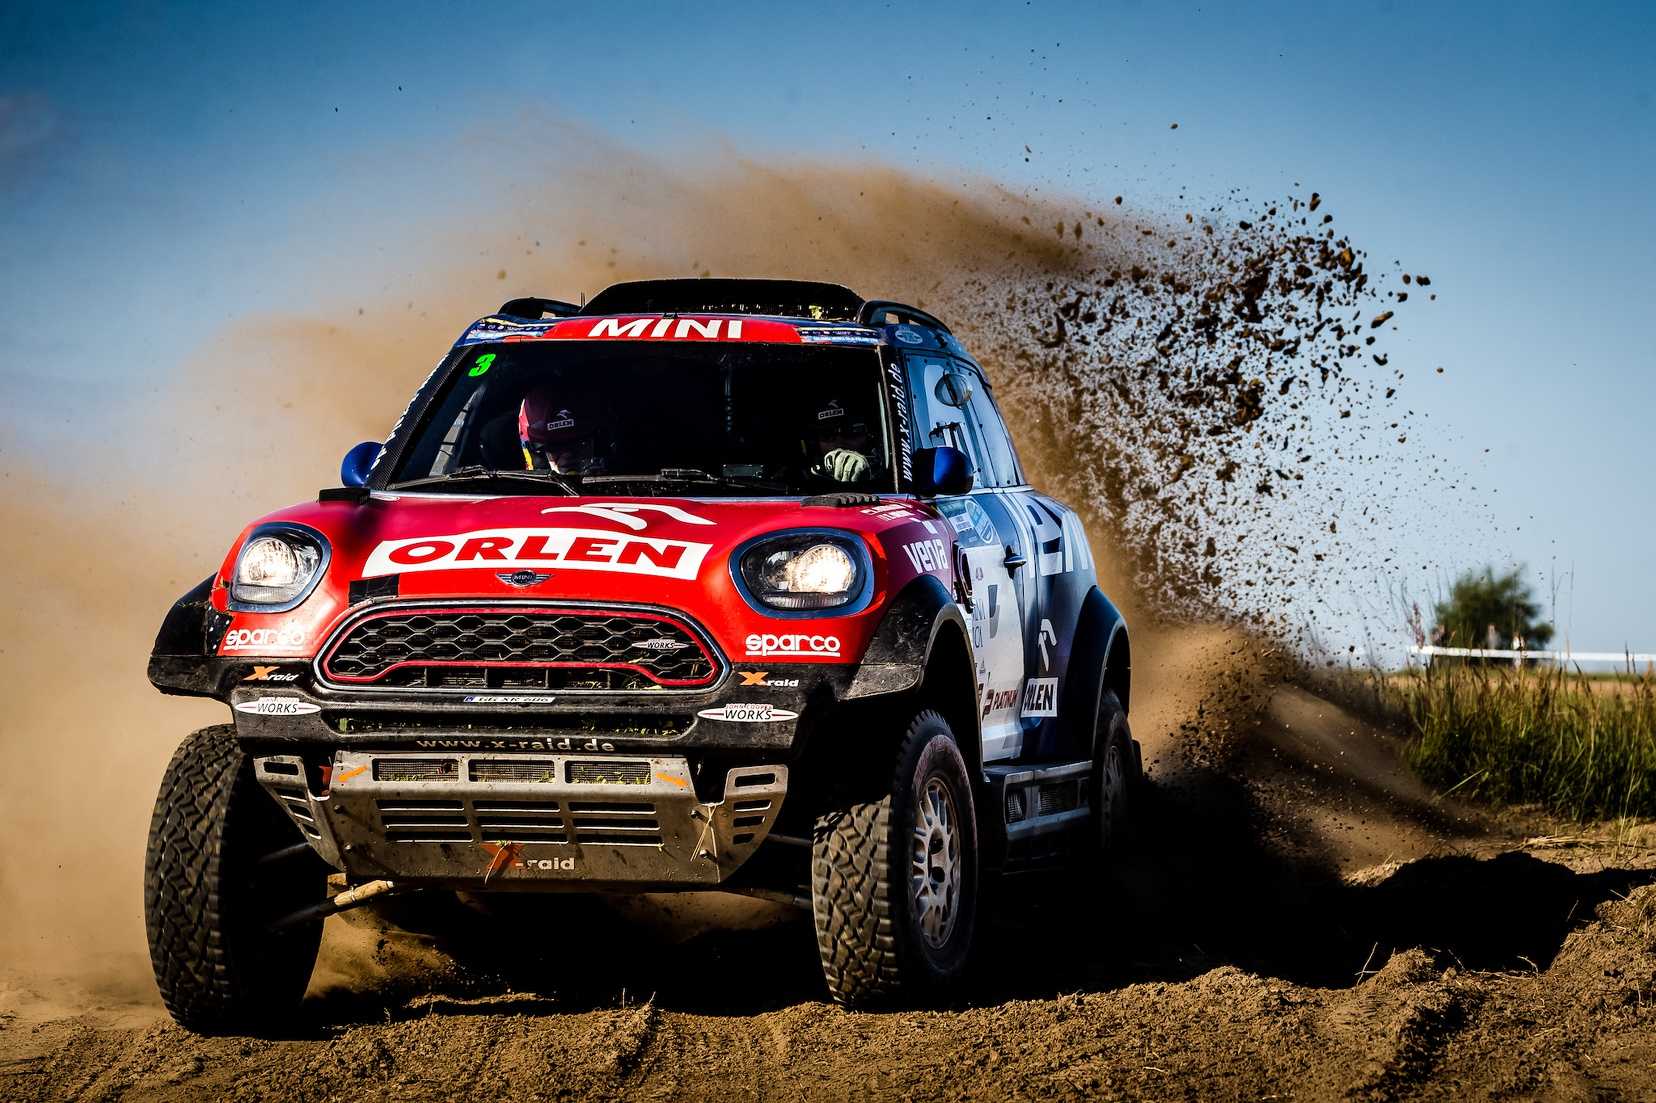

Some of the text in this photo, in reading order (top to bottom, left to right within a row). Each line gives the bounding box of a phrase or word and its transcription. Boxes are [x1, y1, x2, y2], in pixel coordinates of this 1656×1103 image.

[588, 318, 742, 338] MINI
[468, 354, 496, 377] 3
[388, 535, 687, 568] ORLEN
[745, 634, 840, 656] sparco
[258, 703, 298, 713] WORKS
[724, 710, 772, 719] WORKS
[416, 738, 615, 751] www.x-raid.de
